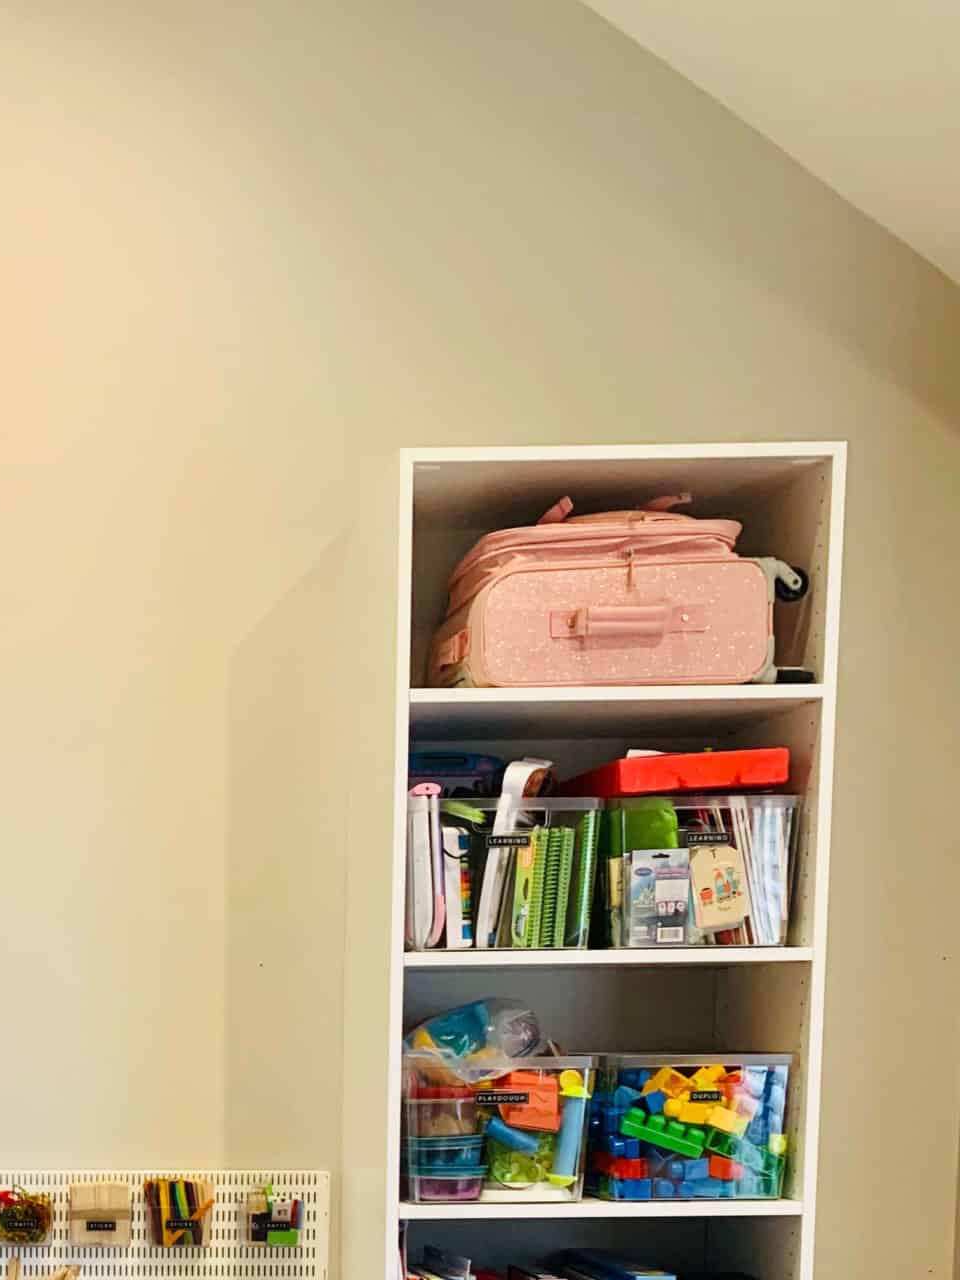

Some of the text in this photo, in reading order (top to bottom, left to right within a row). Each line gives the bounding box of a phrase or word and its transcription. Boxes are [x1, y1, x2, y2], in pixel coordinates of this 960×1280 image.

[488, 836, 528, 845] LEARNING
[688, 833, 728, 842] LEARNING
[476, 1094, 527, 1102] PLAYDOUGH
[691, 1092, 719, 1101] DUPLO
